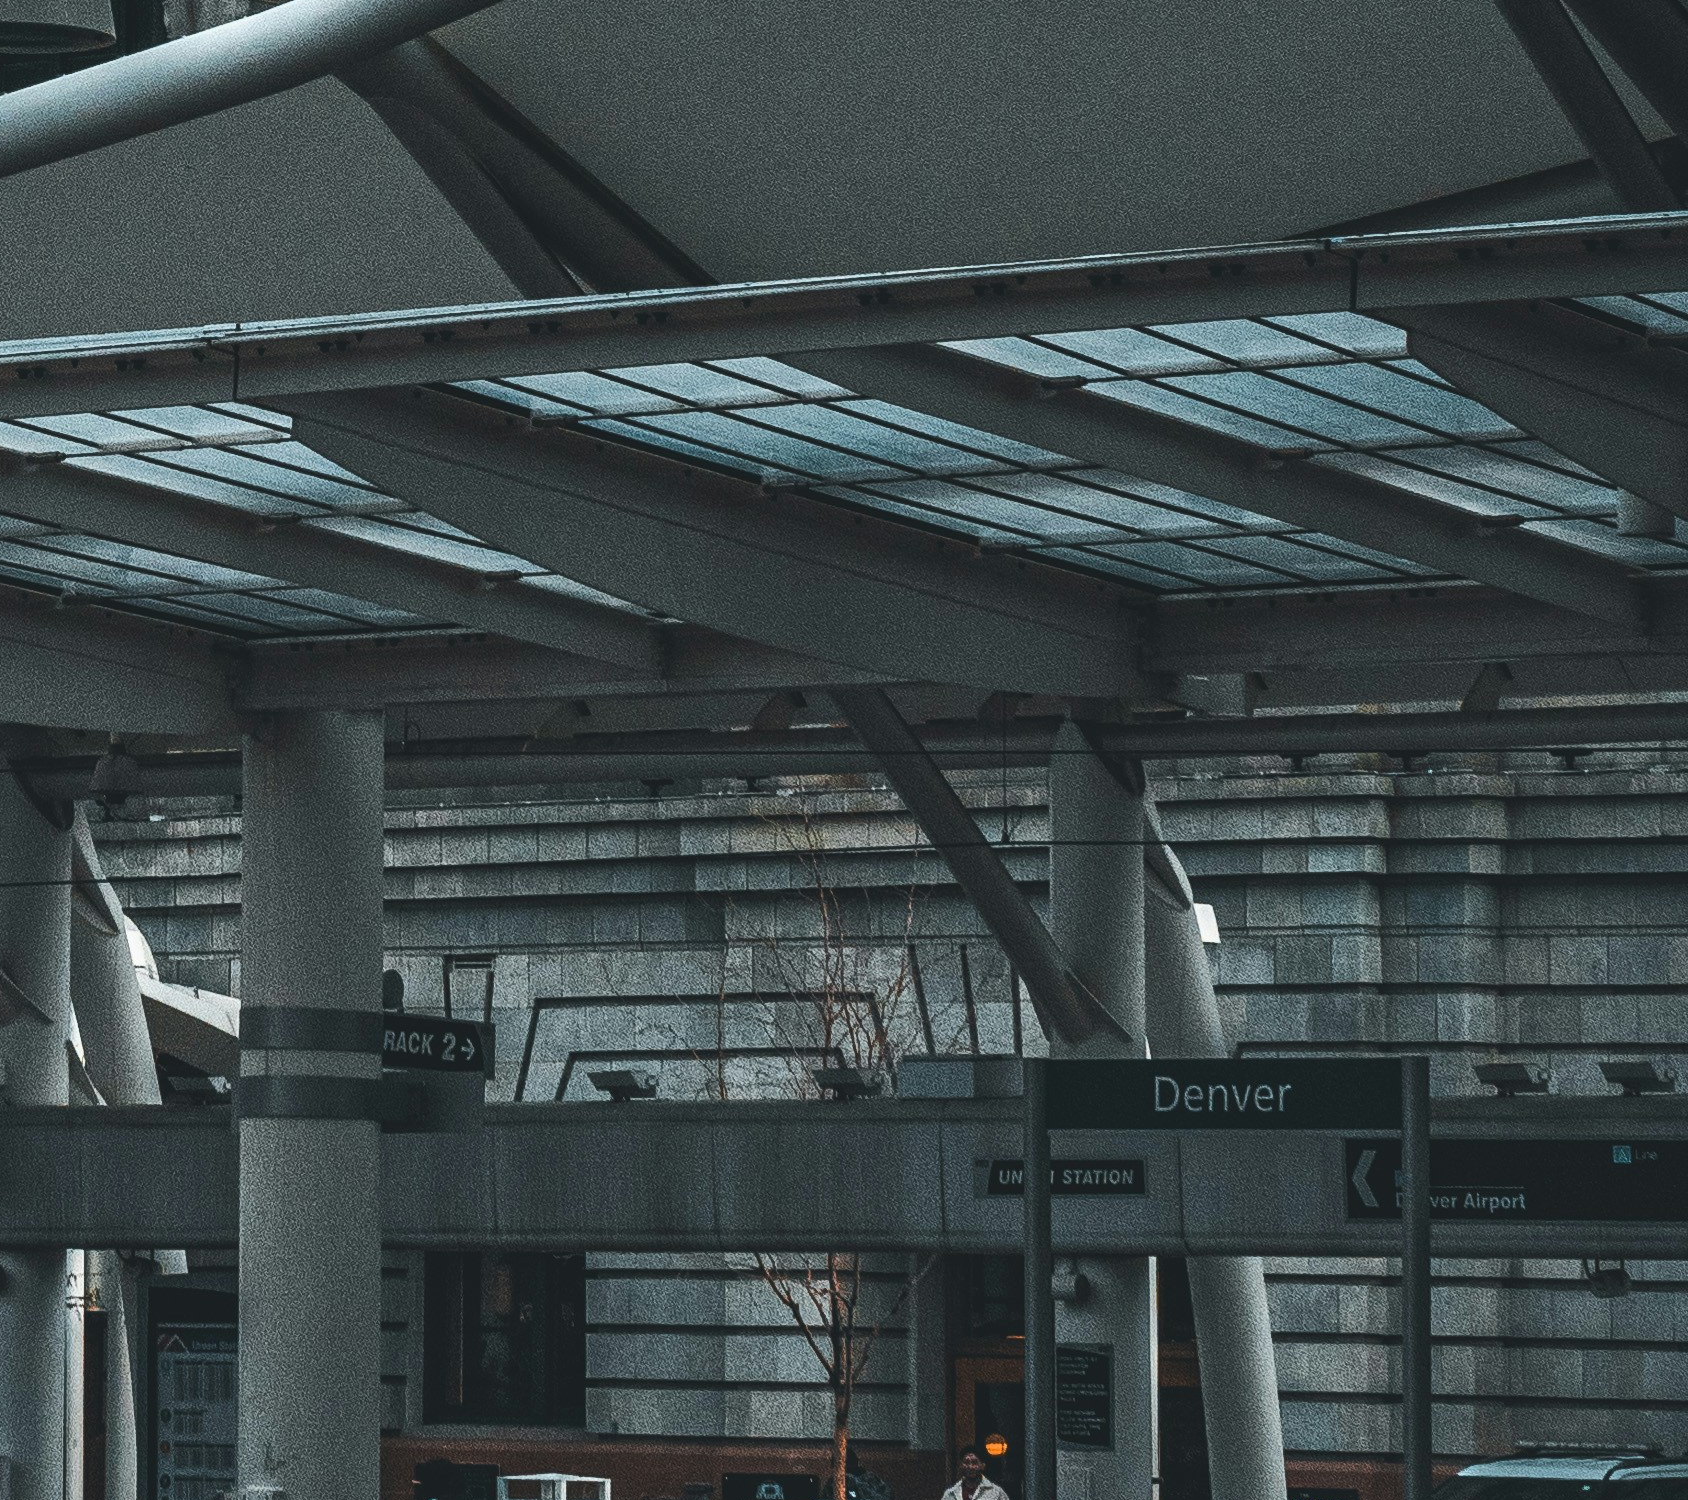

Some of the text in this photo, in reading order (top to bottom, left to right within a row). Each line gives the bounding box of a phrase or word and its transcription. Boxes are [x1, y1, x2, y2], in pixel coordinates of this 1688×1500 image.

[383, 1029, 457, 1062] RACK 2
[1154, 1075, 1292, 1112] Denver
[1062, 1169, 1134, 1185] STATION
[1396, 1191, 1526, 1213] Dver Airport
